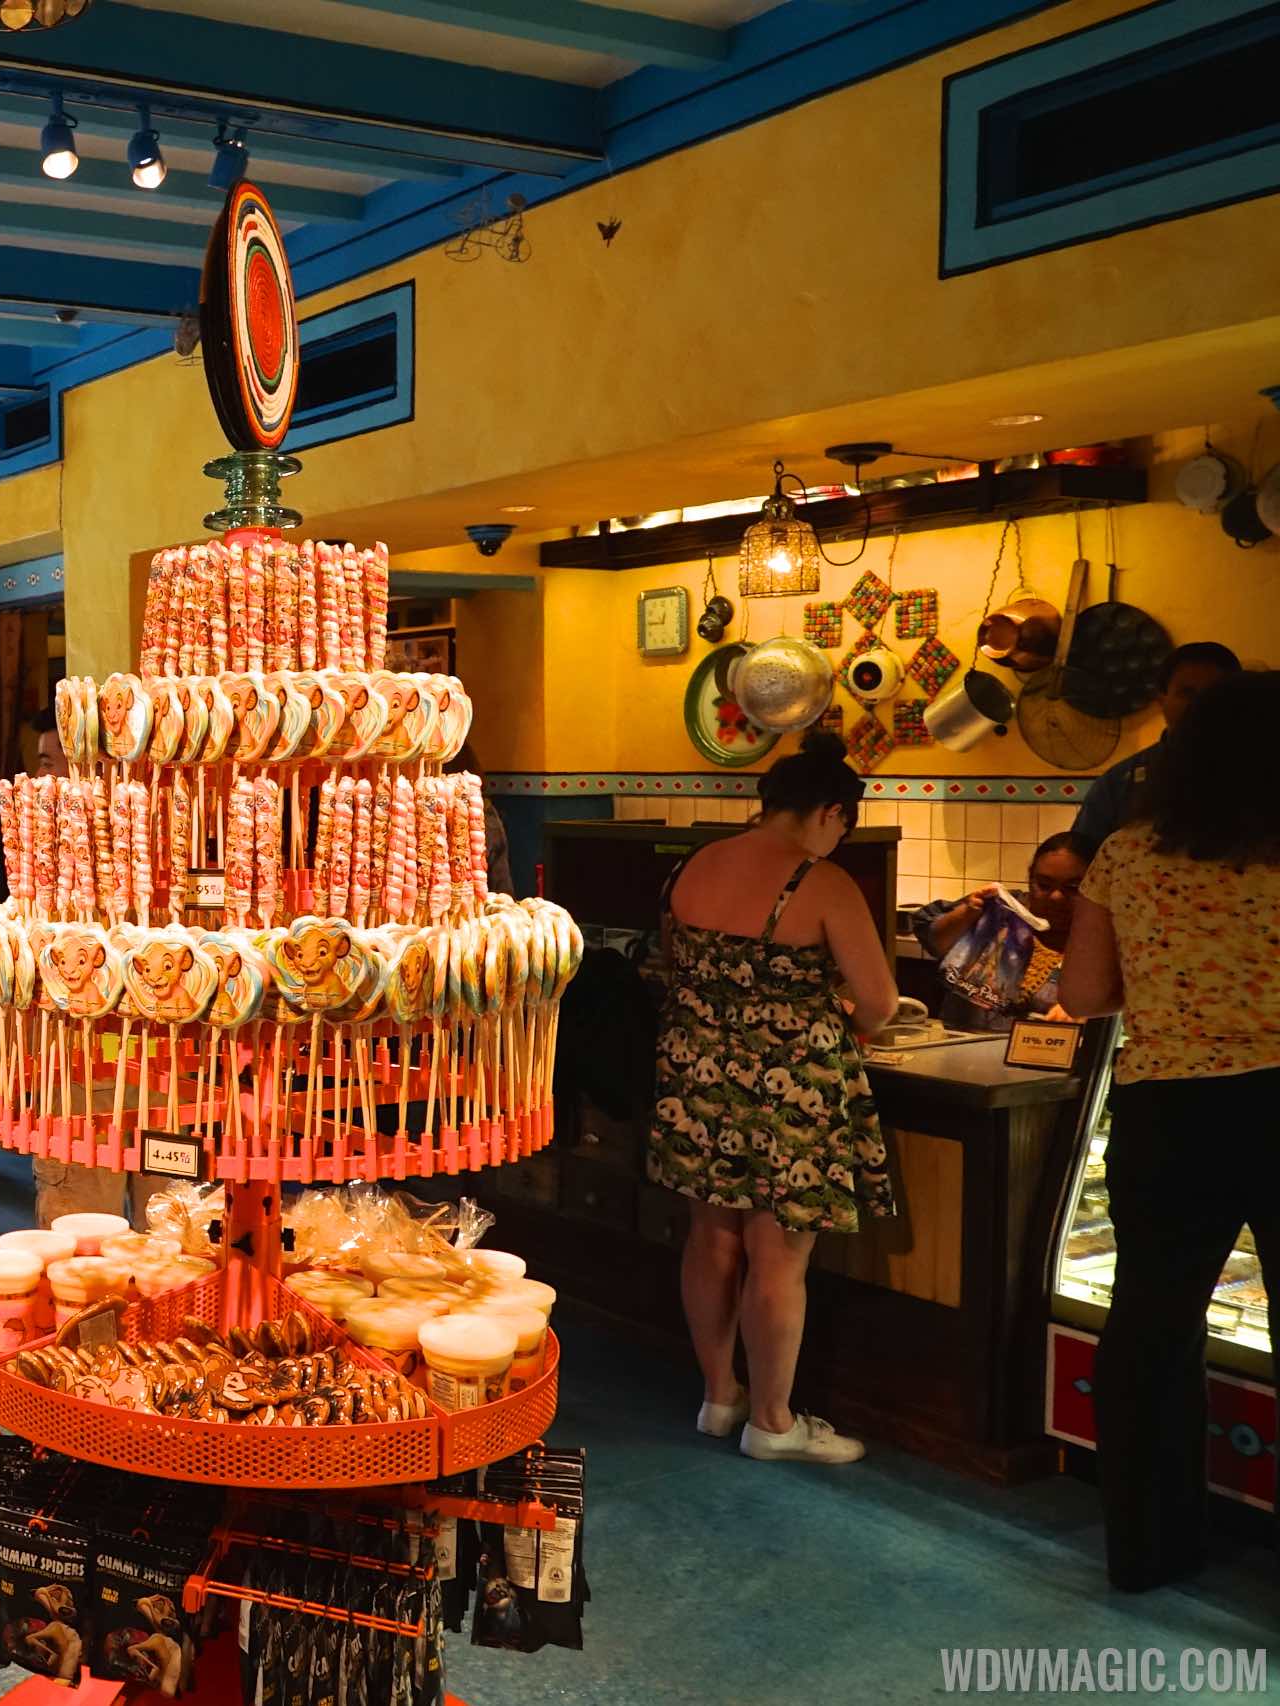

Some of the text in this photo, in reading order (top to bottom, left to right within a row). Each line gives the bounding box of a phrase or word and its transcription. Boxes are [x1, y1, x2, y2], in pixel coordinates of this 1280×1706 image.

[1045, 1037, 1066, 1047] OFF
[152, 1149, 179, 1162] 4.45
[40, 1557, 85, 1577] SPIDERS
[97, 1554, 139, 1577] GUMMY
